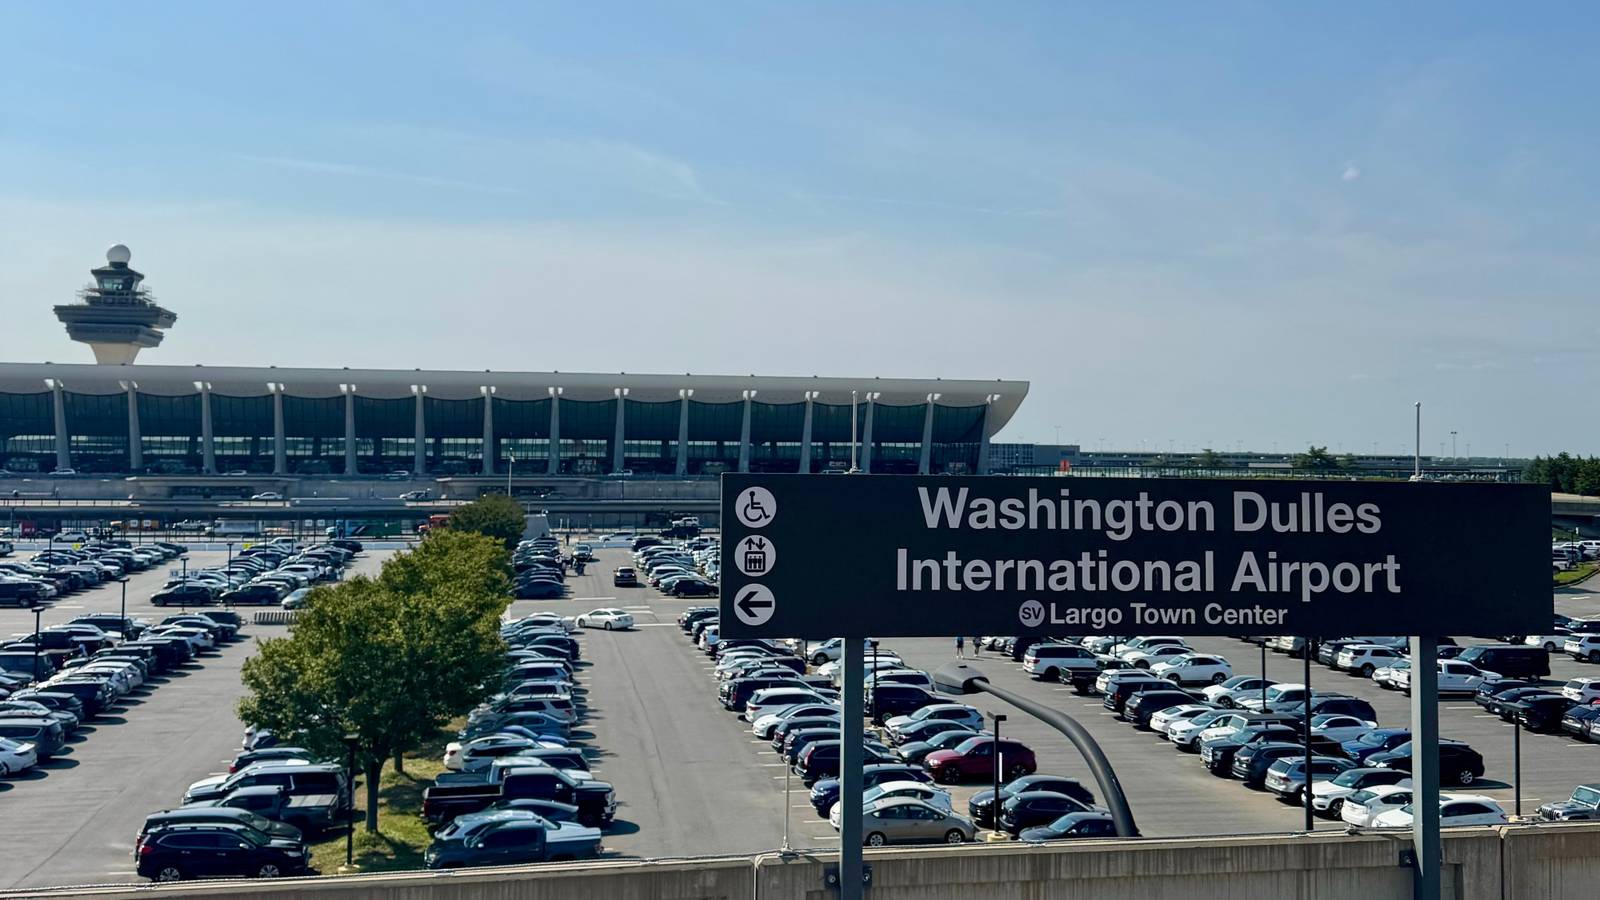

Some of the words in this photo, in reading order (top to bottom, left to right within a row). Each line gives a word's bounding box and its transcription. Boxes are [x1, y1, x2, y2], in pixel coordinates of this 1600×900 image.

[918, 486, 1215, 541] Washington
[1233, 491, 1382, 534] Dulles
[897, 548, 1214, 593] International
[1230, 551, 1401, 602] Airport
[1021, 607, 1043, 620] SV
[1050, 602, 1123, 629] Largo
[1130, 602, 1196, 625] Town
[1204, 602, 1288, 625] Center
